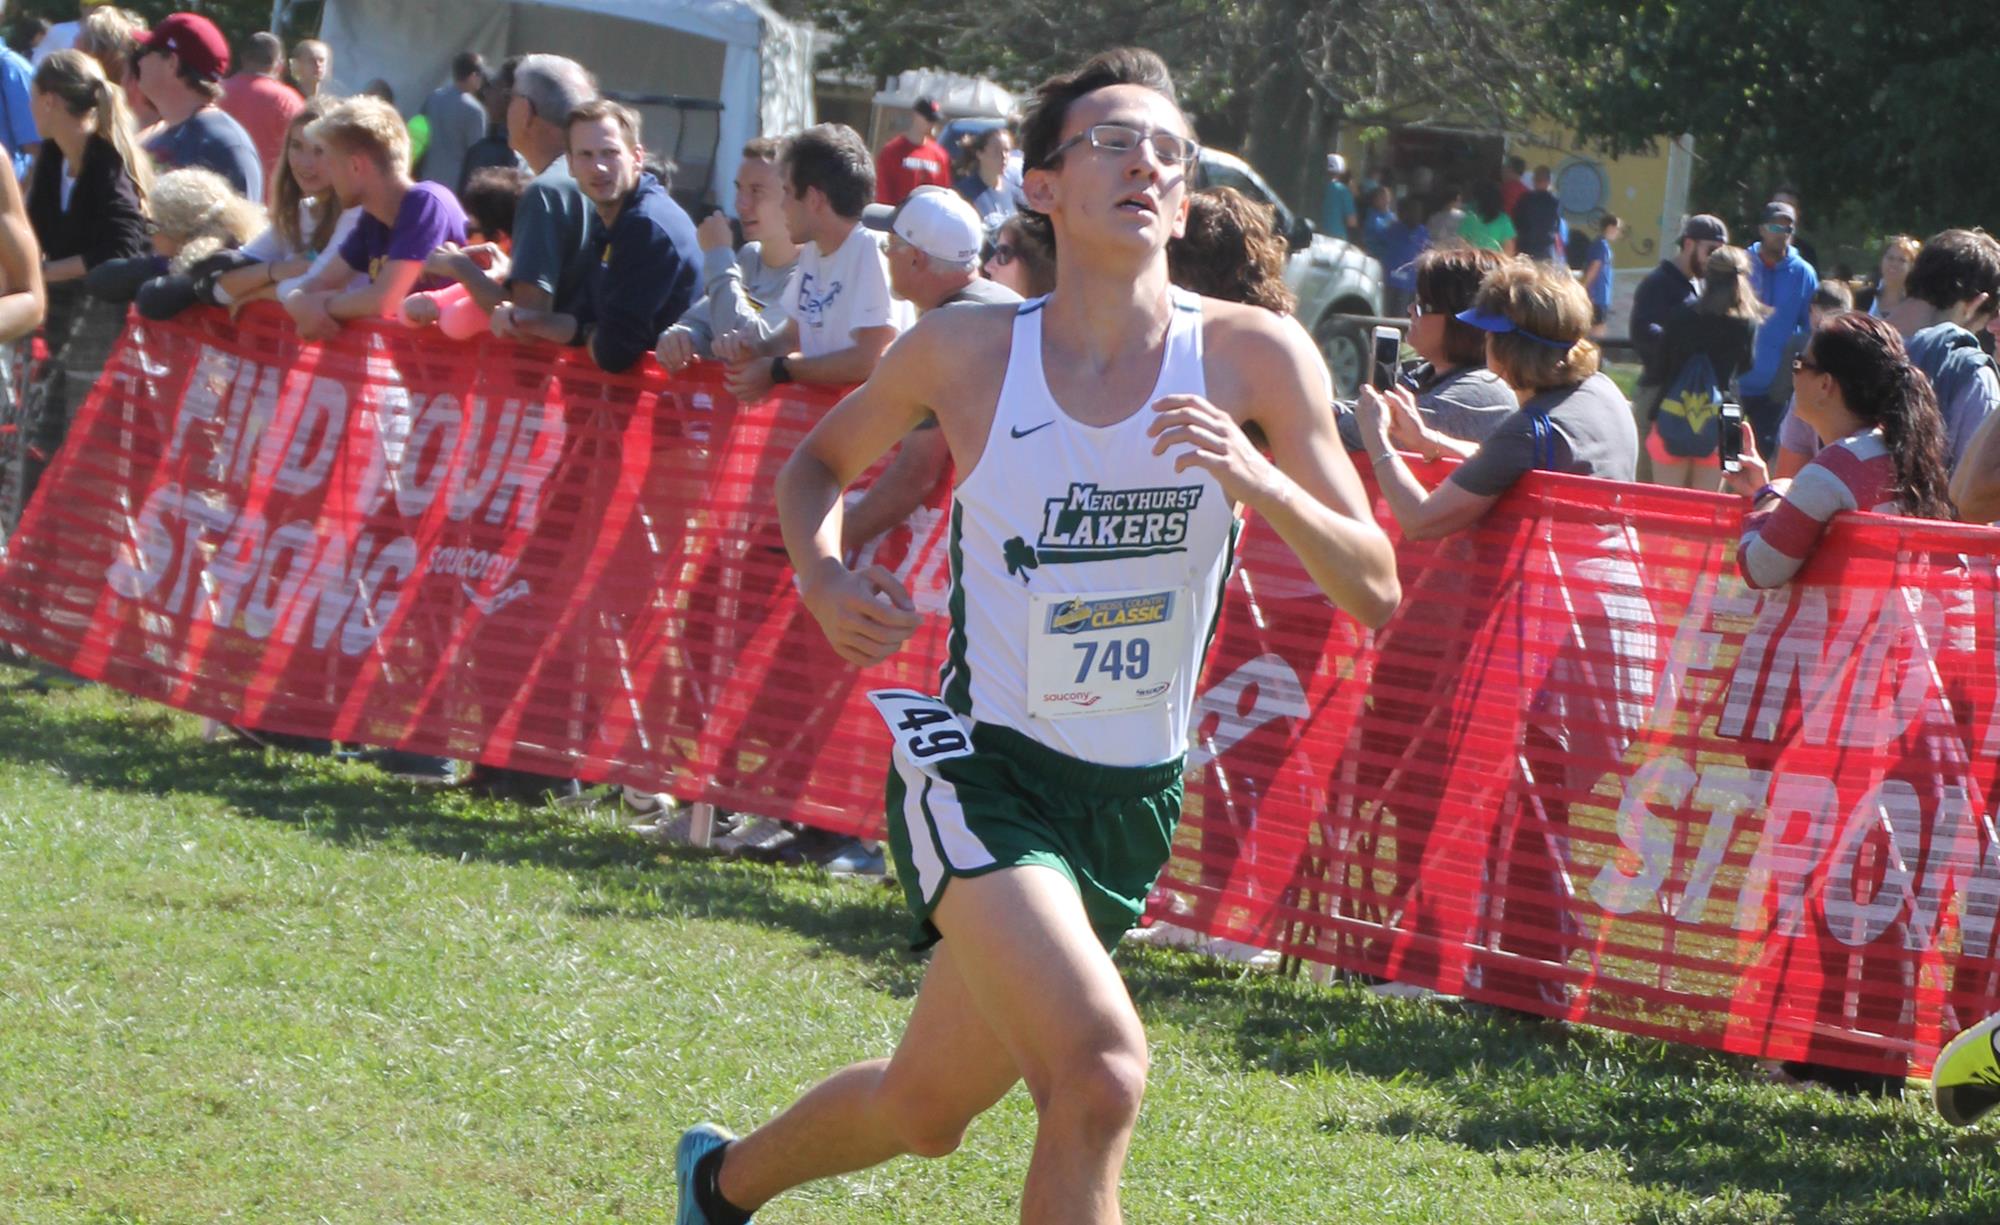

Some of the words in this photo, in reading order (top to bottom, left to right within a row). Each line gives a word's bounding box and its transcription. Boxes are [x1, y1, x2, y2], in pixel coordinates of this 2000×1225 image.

[169, 344, 348, 495] FIND
[354, 384, 568, 530] YOUR
[1041, 501, 1187, 546] LAKERS
[106, 481, 418, 656] STRONG
[425, 545, 519, 590] saucony
[1092, 604, 1165, 628] CLASSIC
[1073, 638, 1150, 683] 749
[1651, 573, 1945, 748] FIND
[1043, 692, 1090, 702] saucony
